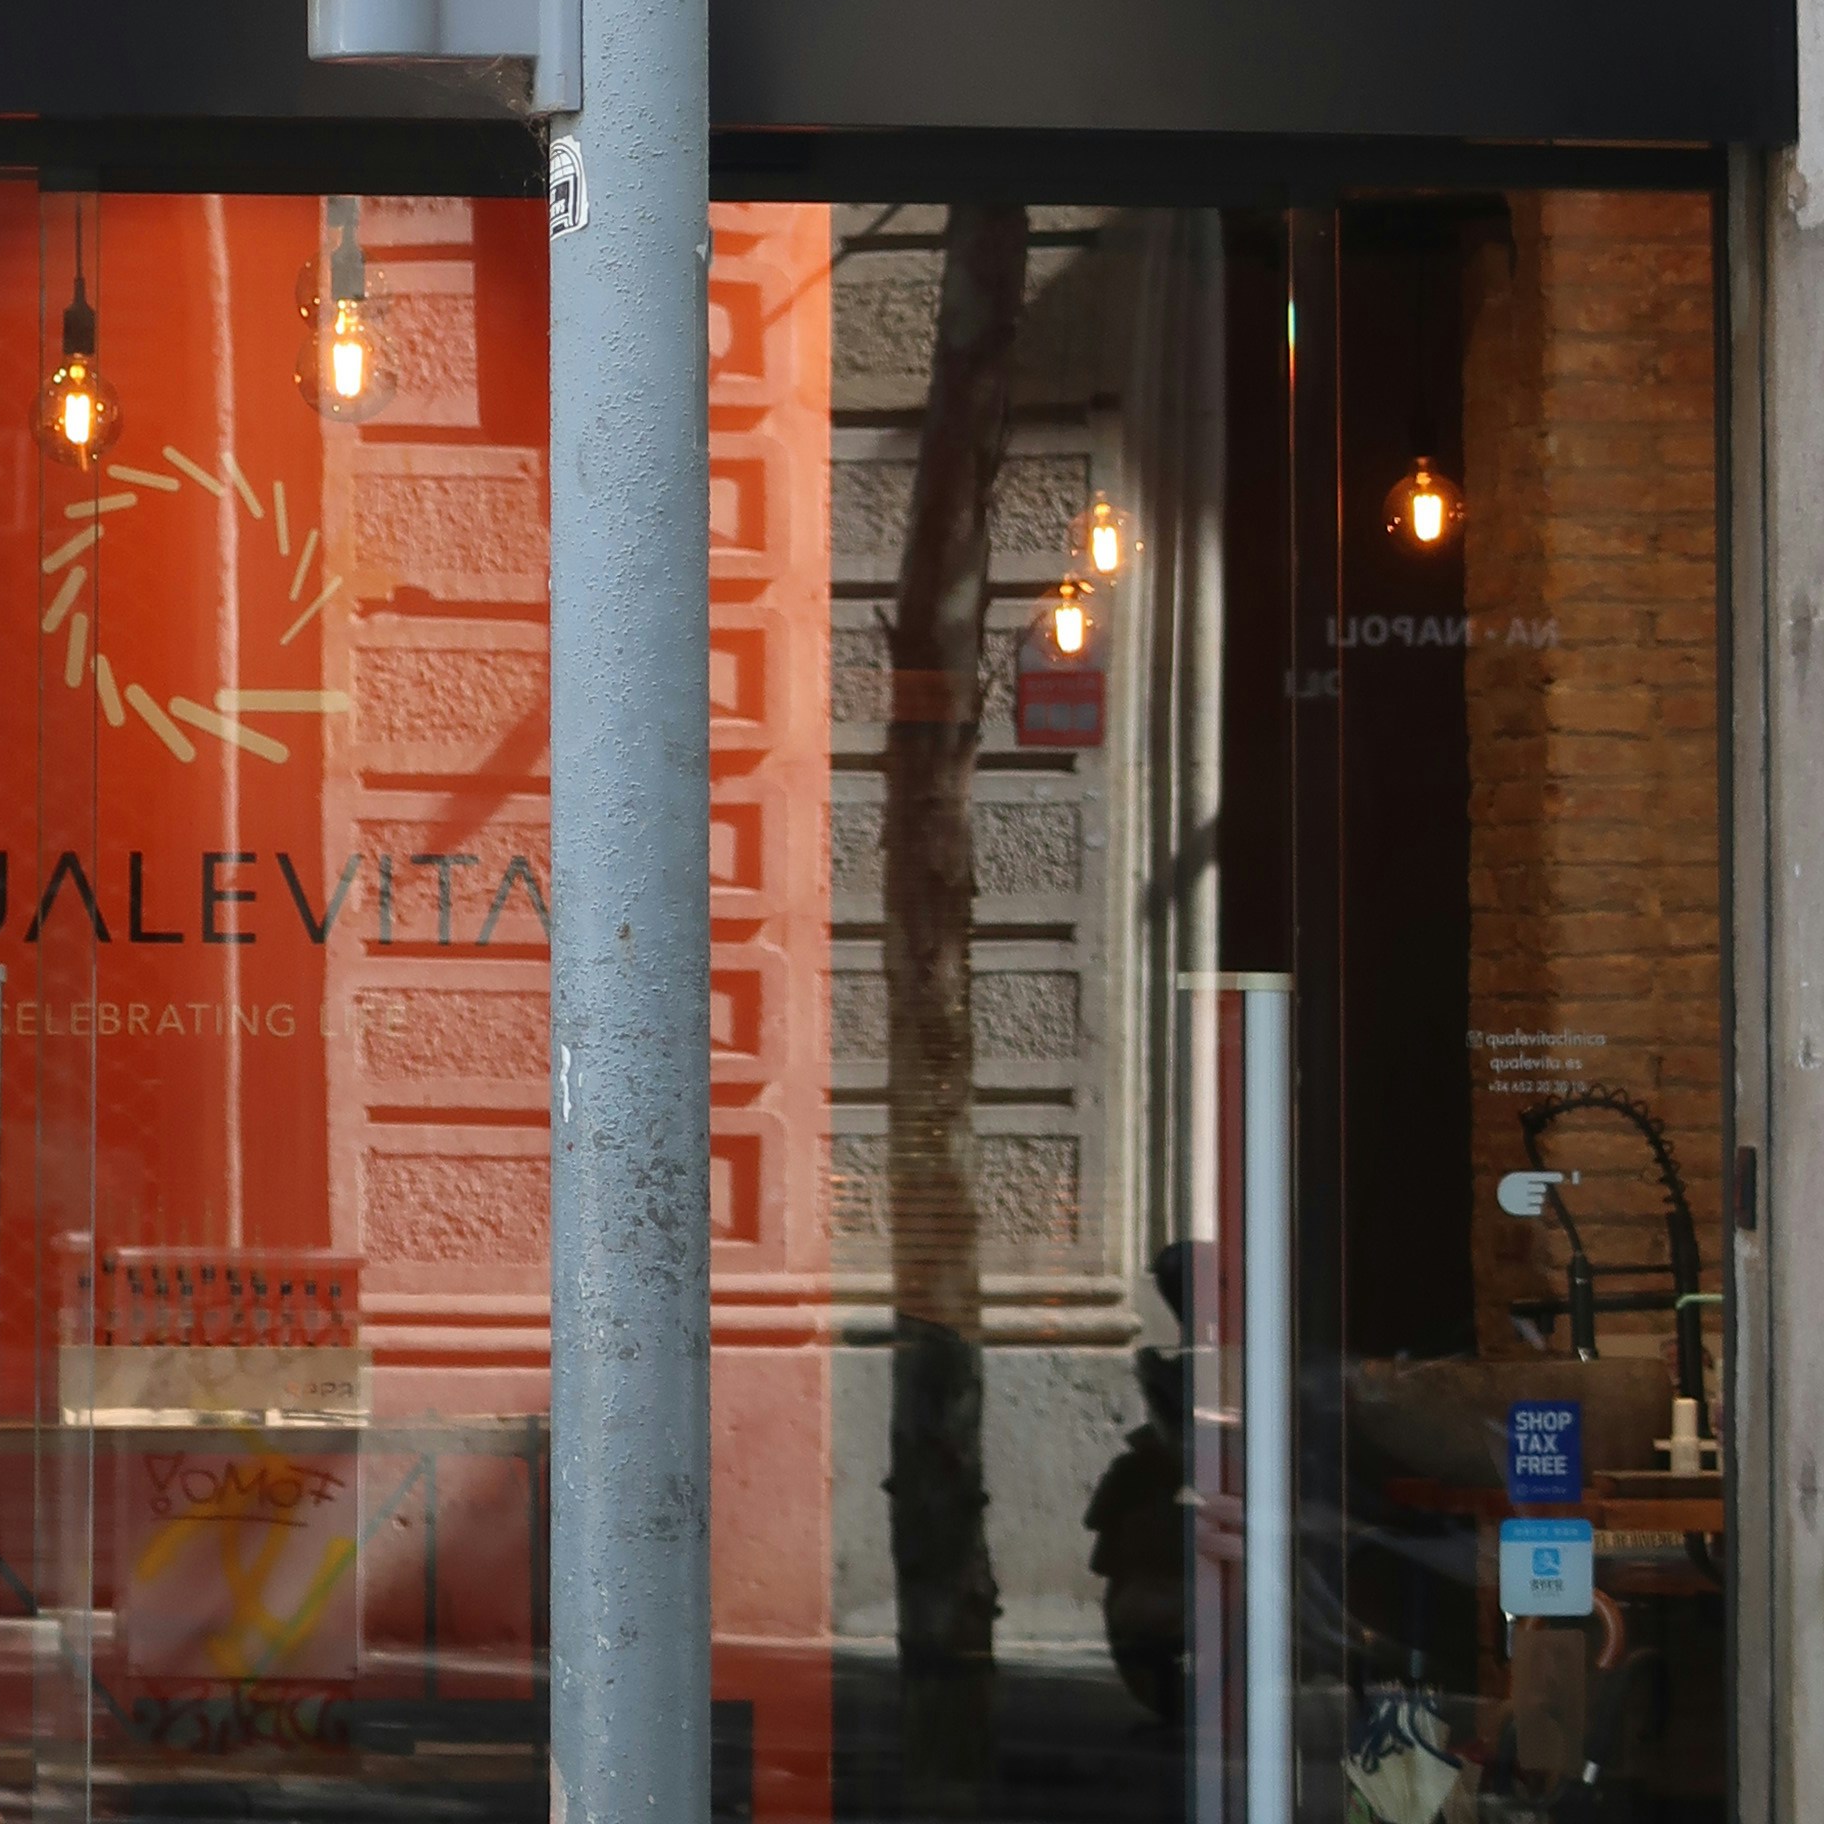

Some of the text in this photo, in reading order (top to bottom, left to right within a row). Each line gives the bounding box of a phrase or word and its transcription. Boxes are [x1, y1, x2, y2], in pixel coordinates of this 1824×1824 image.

[319, 1001, 409, 1038] LIFE
[1515, 1411, 1572, 1431] SHOP
[1515, 1434, 1558, 1453] TAX
[1515, 1455, 1569, 1475] FREE
